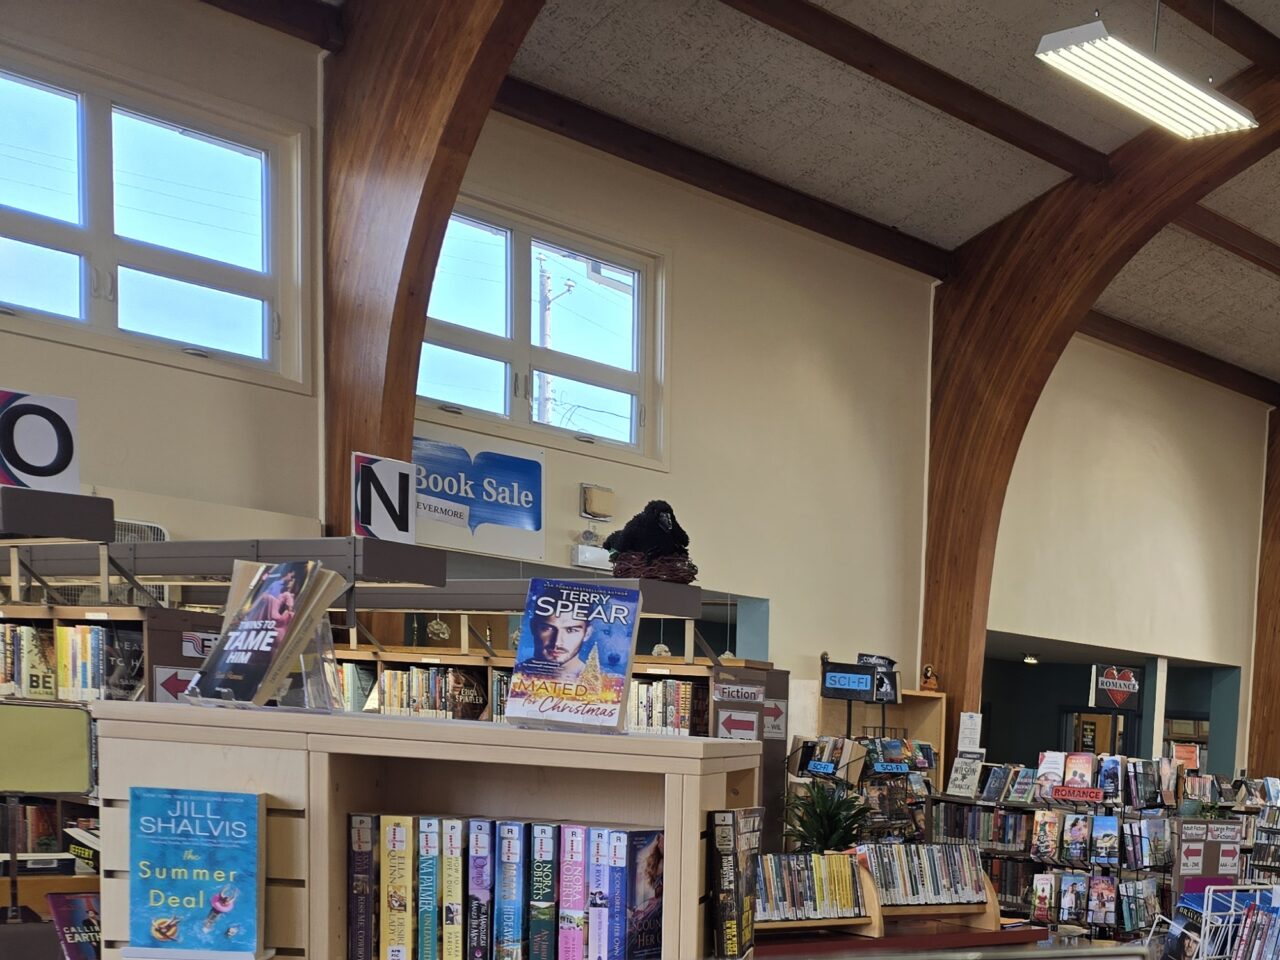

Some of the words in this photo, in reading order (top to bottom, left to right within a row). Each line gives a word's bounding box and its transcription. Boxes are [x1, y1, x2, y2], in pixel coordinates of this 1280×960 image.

[0, 403, 74, 477] O
[416, 466, 475, 499] Book
[482, 478, 534, 508] Sale
[360, 464, 410, 533] N
[560, 589, 611, 604] TERRY
[535, 597, 629, 625] SPEAR
[223, 630, 279, 651] TAME
[226, 651, 252, 665] HIM
[517, 679, 588, 697] MATED
[828, 675, 869, 688] SCI-FI
[1100, 679, 1137, 691] ROMANCE
[721, 687, 757, 701] Fiction
[538, 695, 618, 718] Christmas
[811, 762, 830, 771] SCI-FI
[1053, 788, 1101, 800] ROMANCE
[168, 801, 221, 819] JILL
[139, 816, 248, 838] SHALVIS
[138, 861, 238, 882] Summer
[388, 850, 397, 885] QUINN
[397, 856, 405, 879] ELLA
[543, 864, 552, 894] NORA
[563, 860, 573, 908] ROBERTS
[572, 866, 582, 900] NORA
[149, 889, 204, 908] Deal
[419, 876, 433, 912] PALMER
[614, 872, 622, 912] SCOUNDREL
[63, 925, 100, 935] CALLIN
[503, 905, 514, 950] HIDEAWAY
